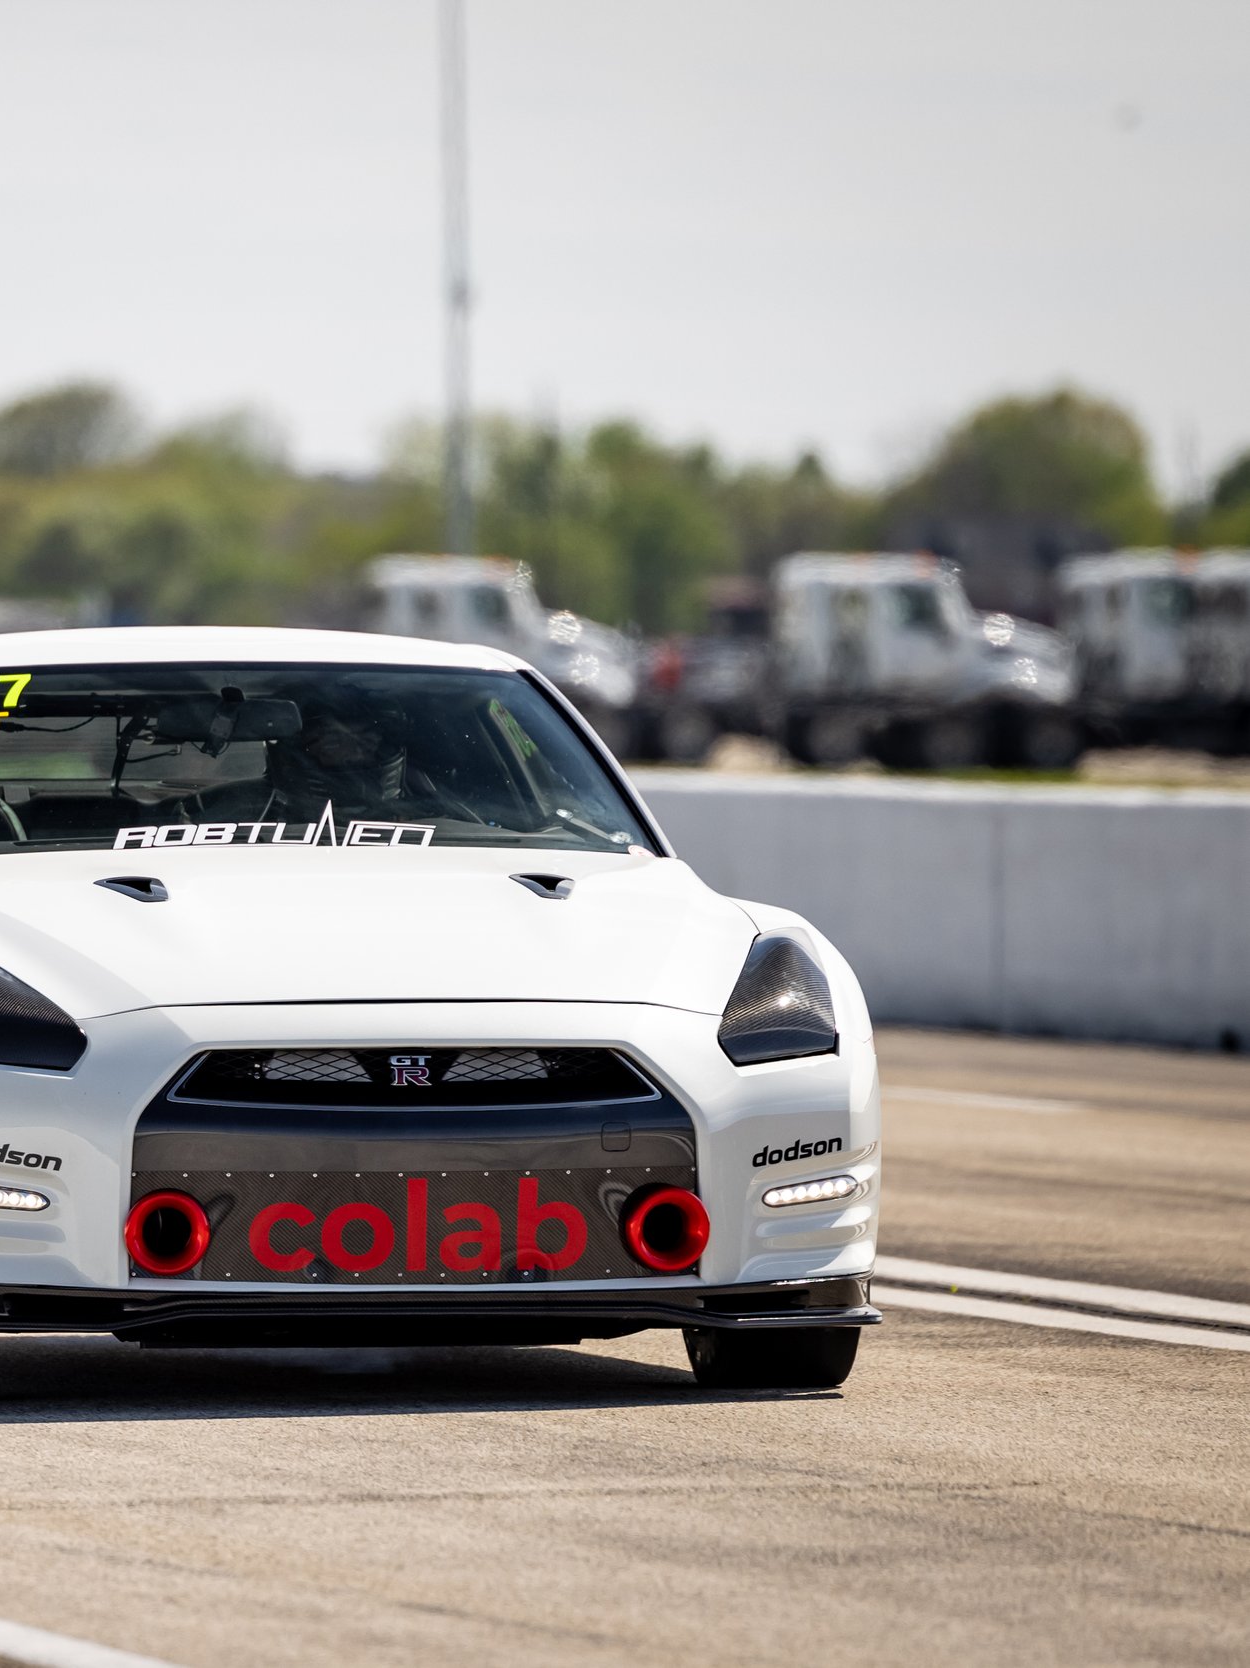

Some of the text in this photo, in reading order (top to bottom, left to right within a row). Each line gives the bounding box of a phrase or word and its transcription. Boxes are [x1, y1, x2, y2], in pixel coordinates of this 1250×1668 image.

[390, 1055, 432, 1066] GT
[390, 1066, 433, 1086] R
[752, 1137, 842, 1168] dodson
[249, 1178, 589, 1273] colab
